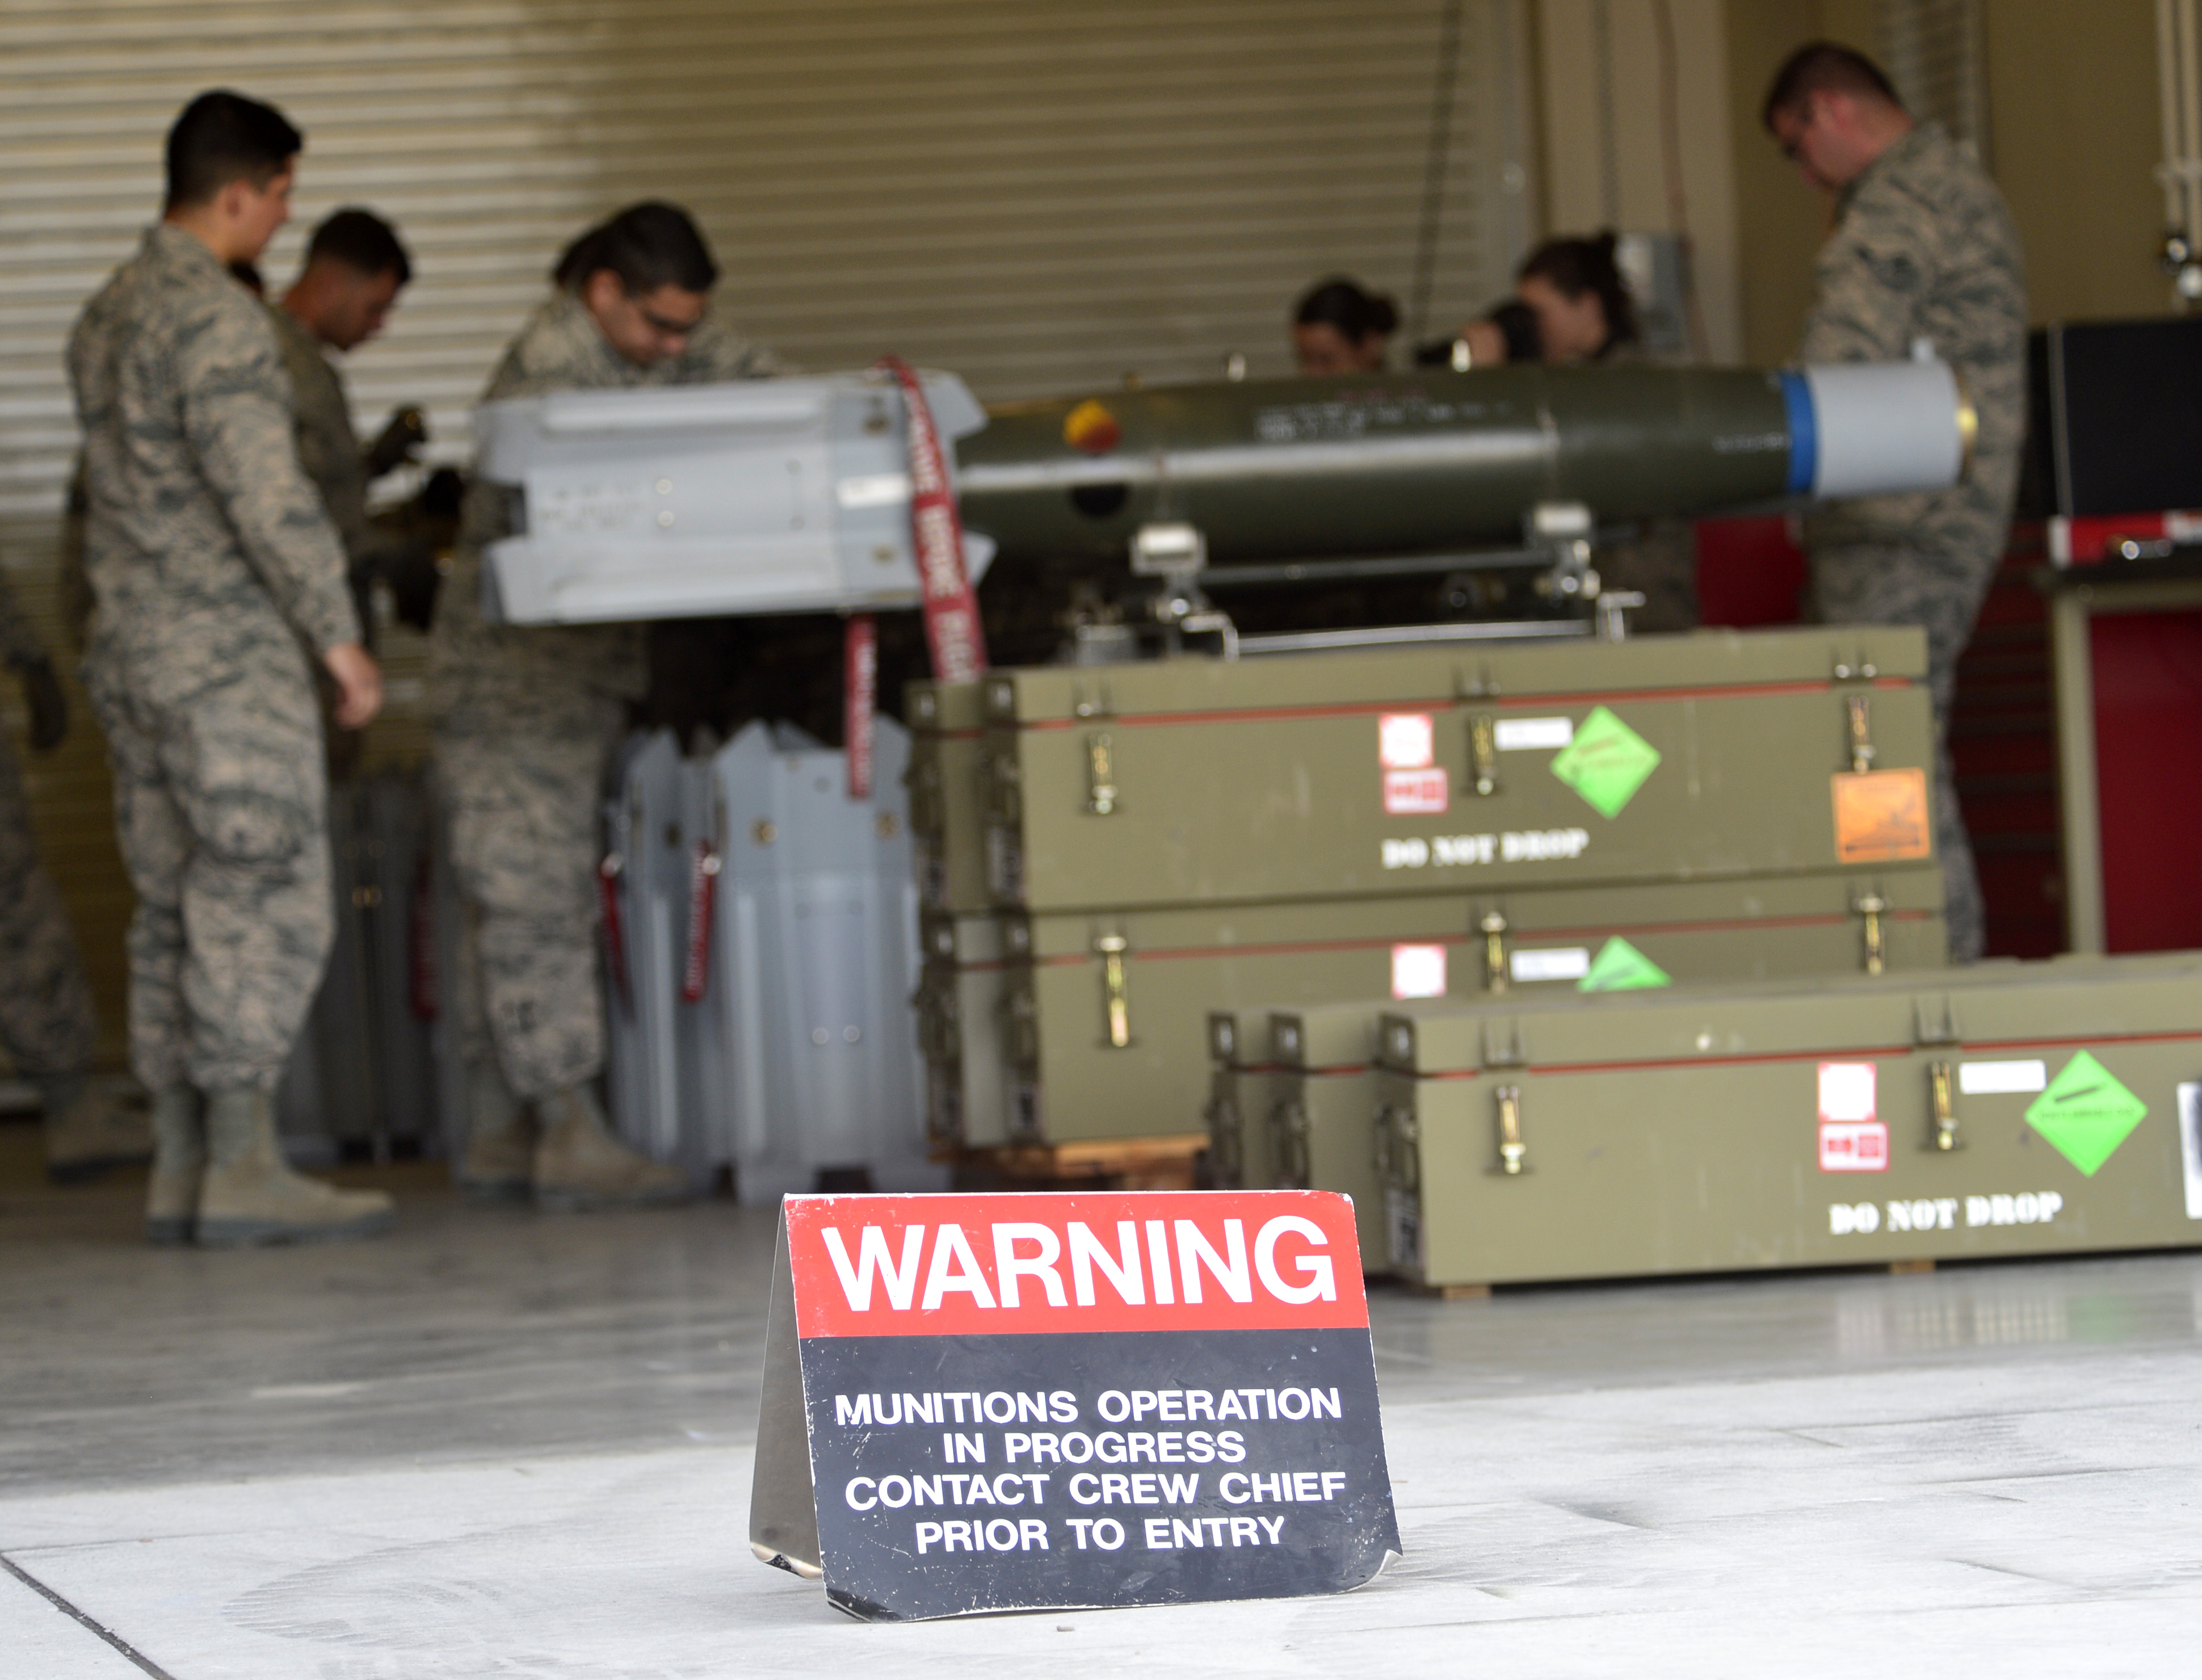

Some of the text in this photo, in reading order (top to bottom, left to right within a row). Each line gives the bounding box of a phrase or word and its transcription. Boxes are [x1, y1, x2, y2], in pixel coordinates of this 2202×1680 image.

[1382, 829, 1589, 868] DO NOT DROP
[1829, 1191, 2063, 1235] DO NOT DROP
[820, 1215, 1337, 1312] WARNING
[835, 1387, 1342, 1429] MUNITIONS OPERATION
[943, 1430, 1246, 1464] IN PROGRESS
[845, 1471, 1346, 1511] CONTACT CREW CHIEF
[915, 1515, 1285, 1555] PRIOR TO ENTRY
